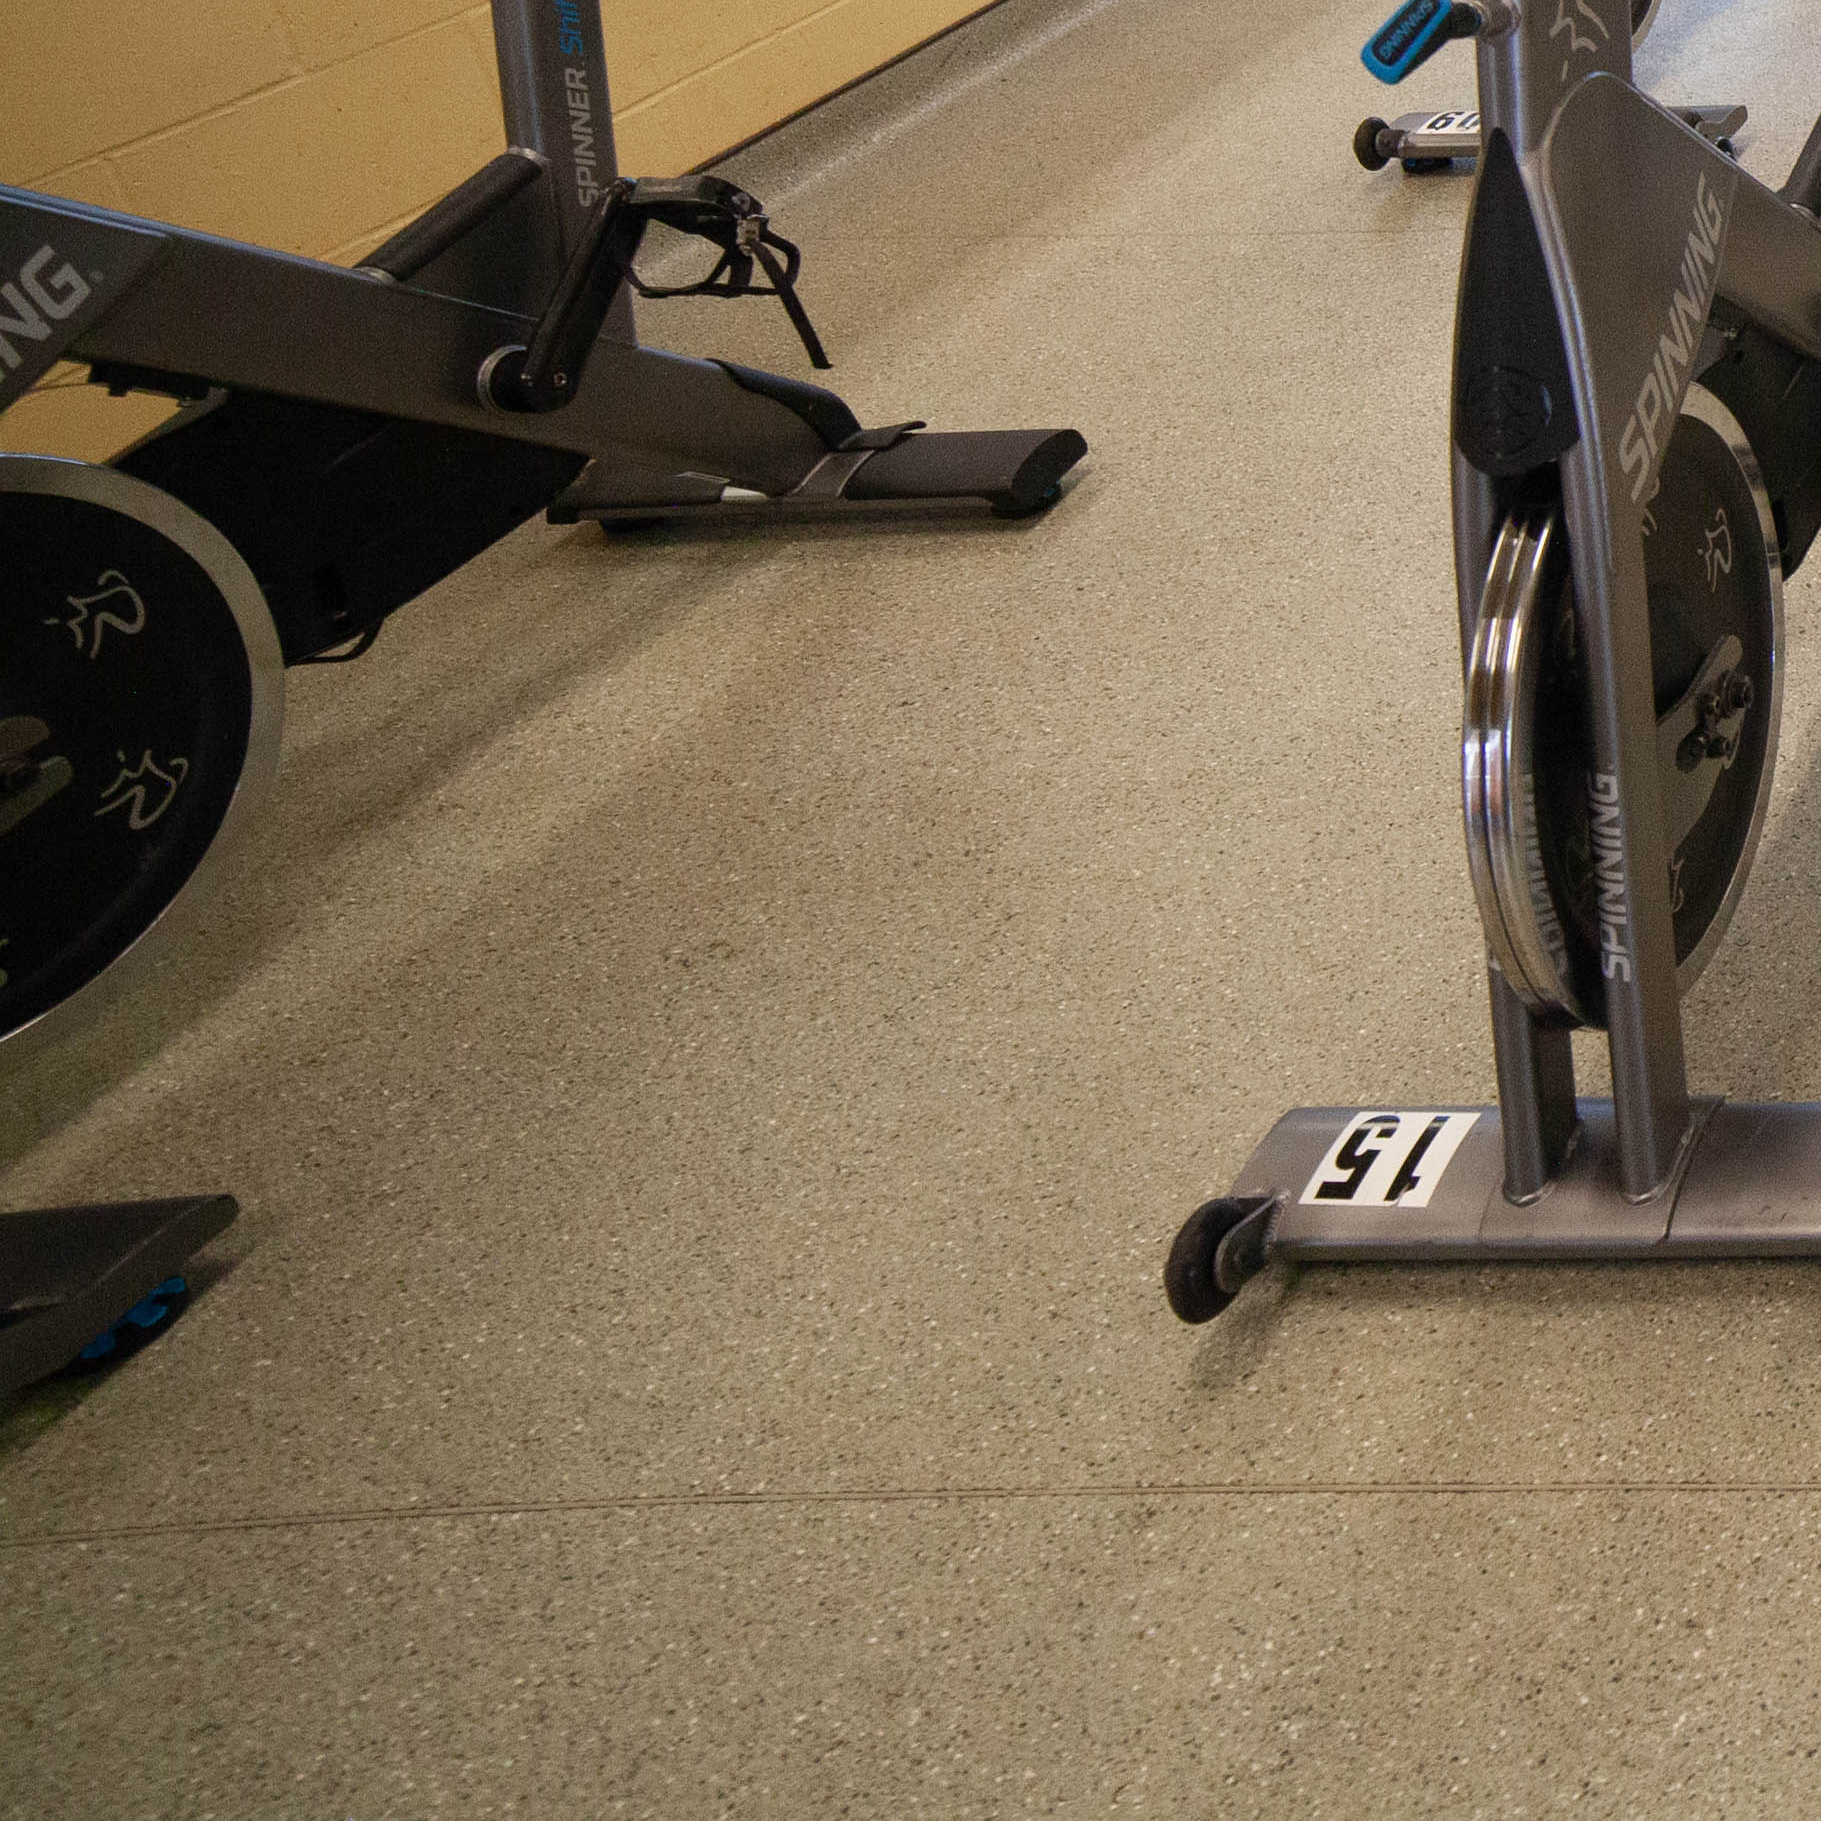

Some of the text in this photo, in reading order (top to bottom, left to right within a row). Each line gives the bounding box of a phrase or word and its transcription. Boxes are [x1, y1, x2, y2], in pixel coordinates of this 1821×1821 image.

[564, 66, 599, 208] SPINNER
[1619, 169, 1724, 504] SPINNING
[1589, 773, 1631, 982] SPINNING
[1313, 1114, 1450, 1202] 15
